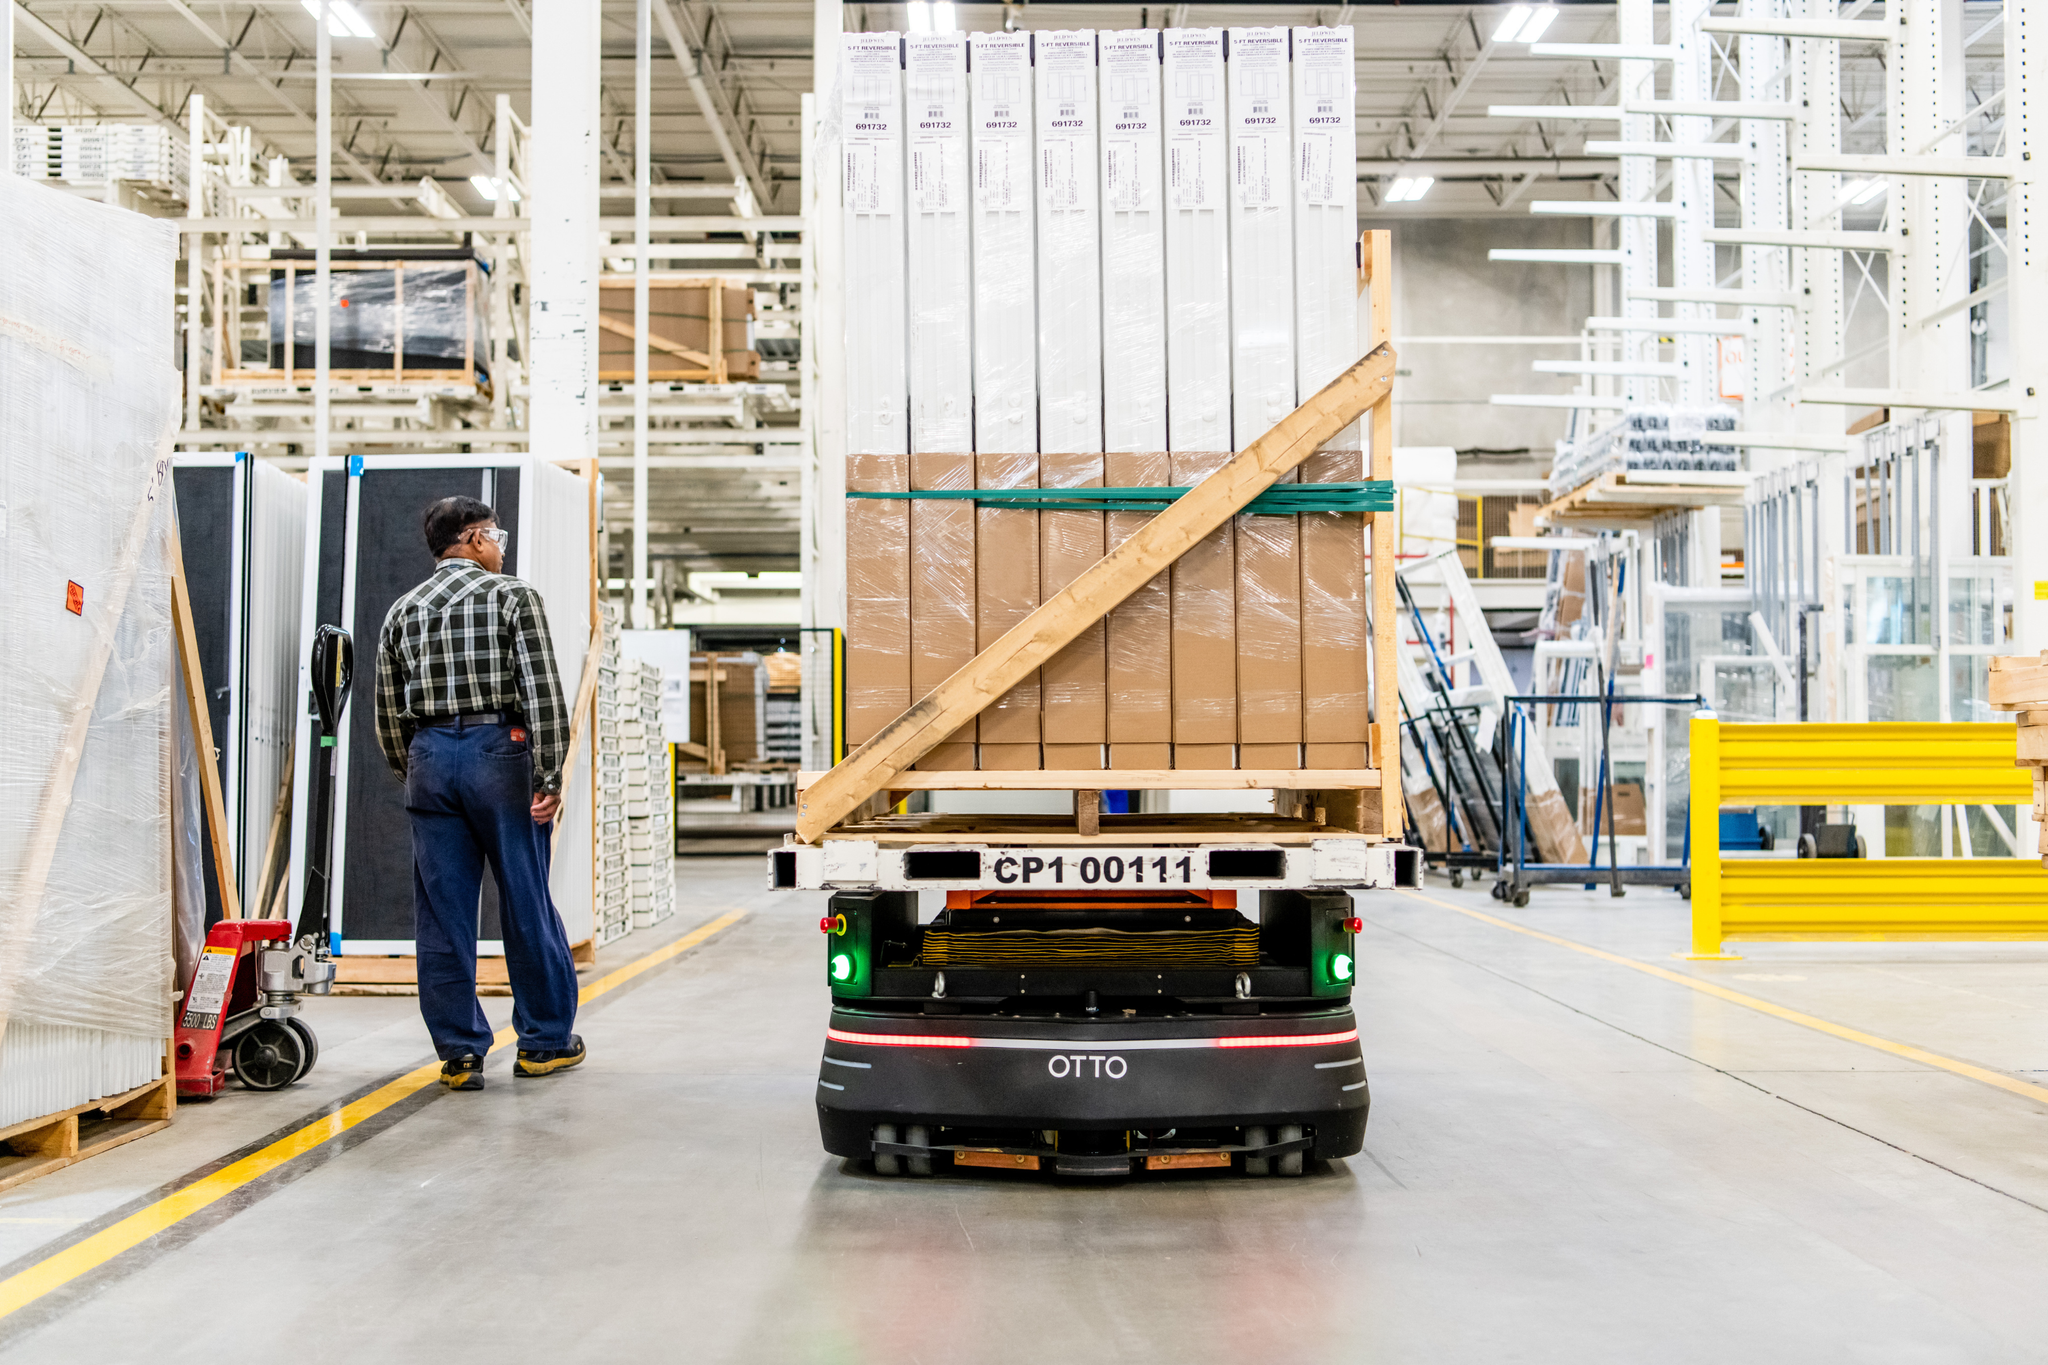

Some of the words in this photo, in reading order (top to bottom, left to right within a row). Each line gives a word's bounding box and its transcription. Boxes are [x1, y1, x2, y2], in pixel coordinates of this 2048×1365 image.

[994, 856, 1063, 884] CP1
[1080, 856, 1191, 884] 00111
[202, 1014, 217, 1030] LBS
[1048, 1055, 1127, 1078] OTTO
